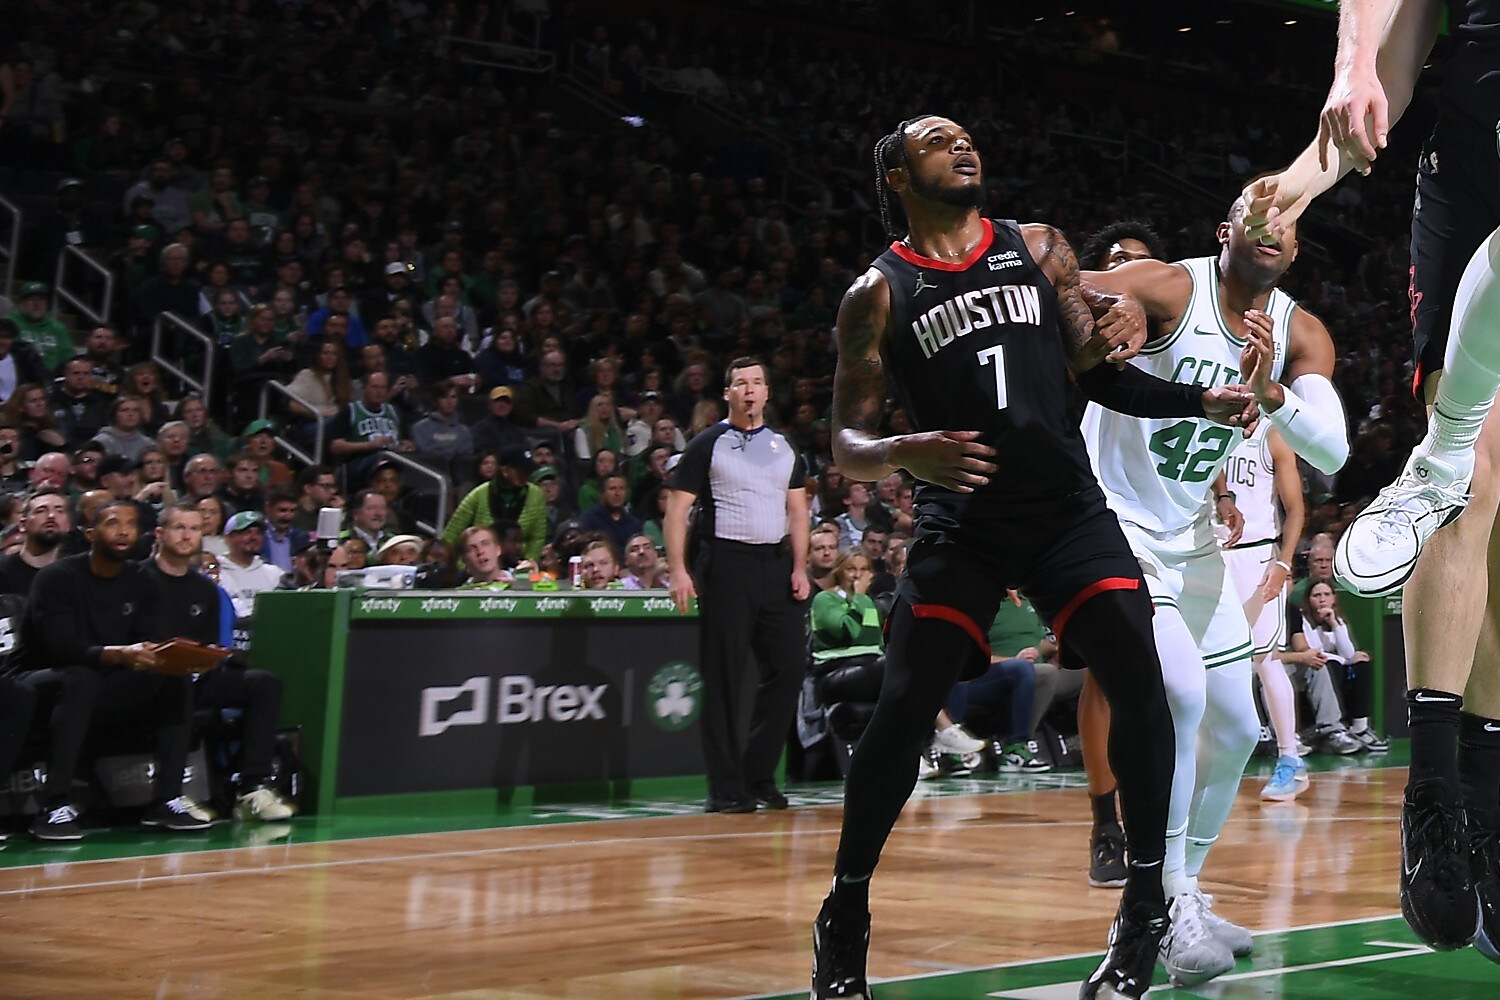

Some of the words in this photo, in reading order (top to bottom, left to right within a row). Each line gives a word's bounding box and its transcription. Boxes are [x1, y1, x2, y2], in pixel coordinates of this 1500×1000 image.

[987, 250, 1020, 263] credit
[988, 258, 1024, 272] karma
[911, 284, 1042, 360] HOUSTON
[976, 344, 1009, 411] 7
[1149, 419, 1235, 483] 42
[360, 596, 401, 613] xfinity
[420, 596, 461, 613] xfinity
[479, 596, 518, 613] xfinity
[590, 596, 626, 612] xfinity
[497, 674, 608, 725] Brex
